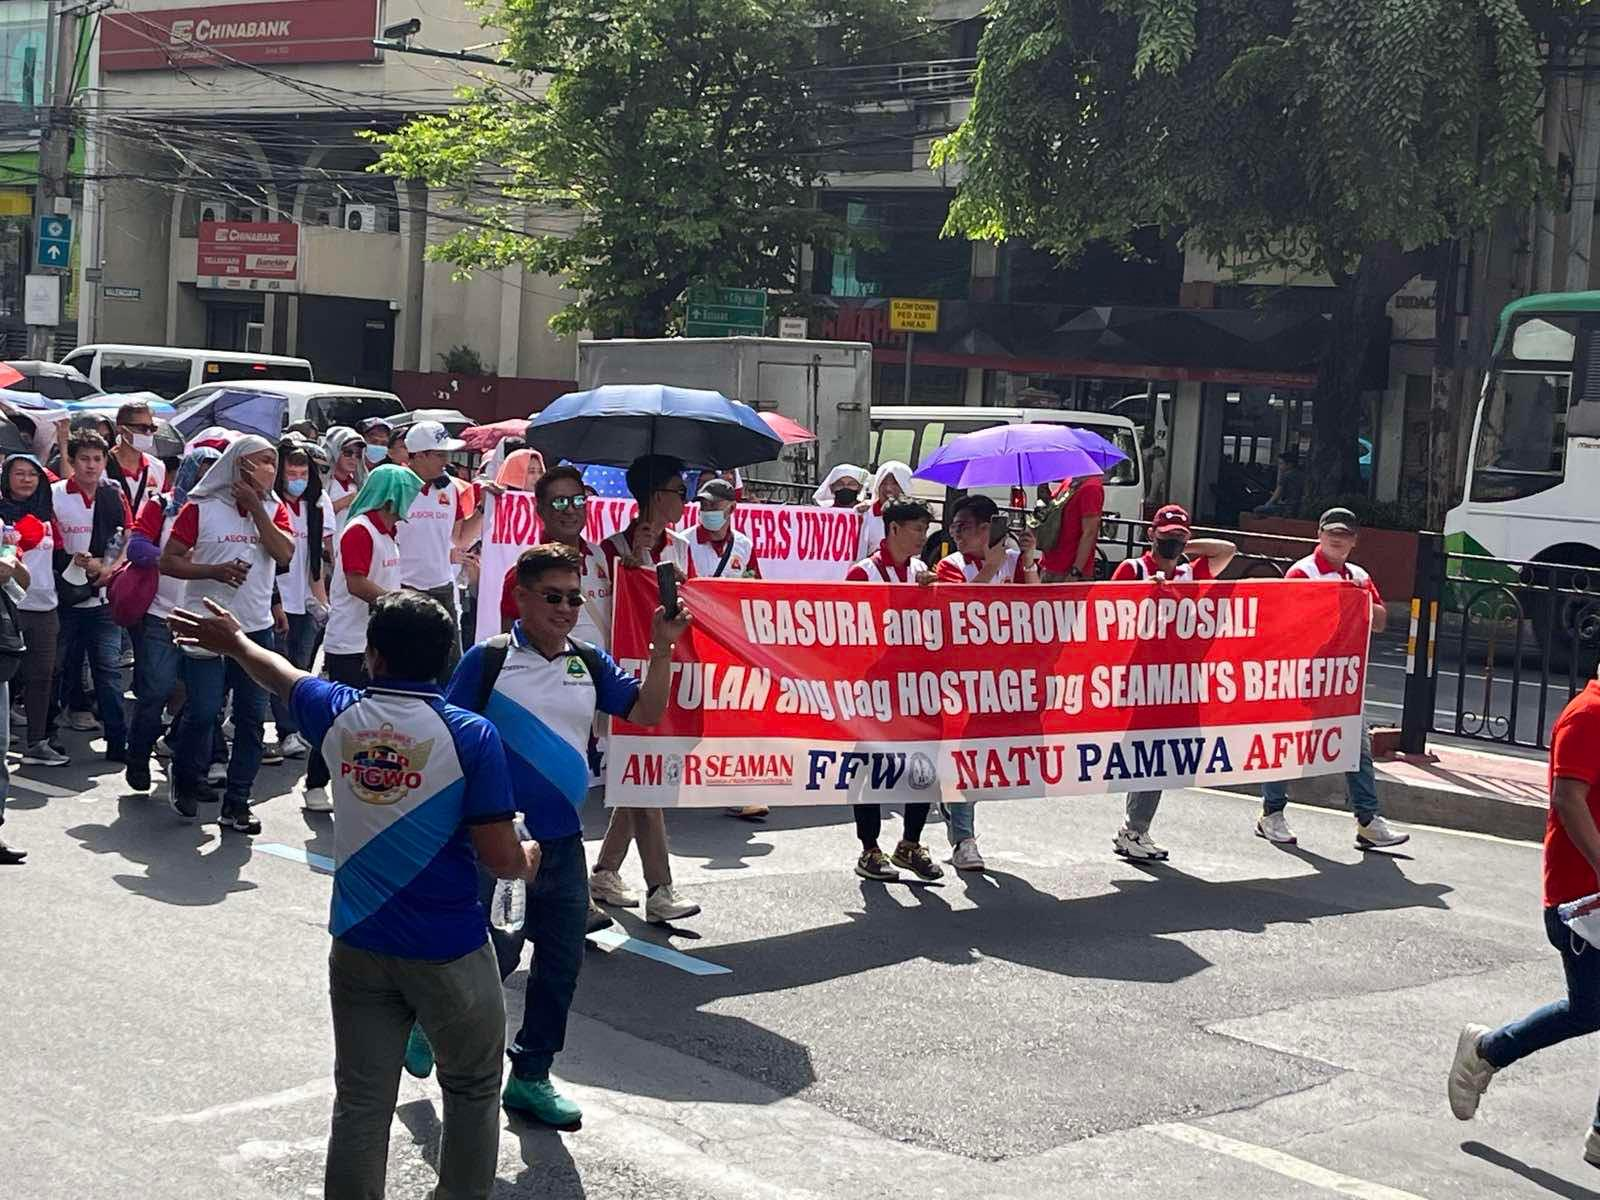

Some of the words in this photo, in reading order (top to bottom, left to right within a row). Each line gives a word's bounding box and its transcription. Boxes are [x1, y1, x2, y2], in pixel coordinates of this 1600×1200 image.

[196, 19, 291, 41] CHINABANK
[229, 229, 281, 242] CHINABANK
[894, 302, 913, 310] SLOW
[914, 303, 936, 311] DOWN
[897, 311, 912, 319] PED
[901, 320, 926, 328] AHEAD
[217, 533, 248, 544] LABOR
[796, 511, 863, 562] UNION
[740, 599, 878, 647] IBASURA
[884, 608, 945, 651] ang
[949, 599, 1088, 647] ESCROW
[1094, 597, 1259, 642] PROPOSAL!
[775, 675, 836, 722] ang
[833, 678, 894, 722] pag
[897, 668, 1040, 718] HOSTAGE
[1045, 673, 1084, 717] ng
[1090, 660, 1239, 710] SEAMAN'S
[1241, 655, 1361, 702] BENEFITS
[705, 754, 794, 778] SEAMAN
[805, 749, 907, 791] FFW
[951, 745, 1066, 790] NATU
[1076, 736, 1234, 783] PAMWA
[1242, 727, 1343, 772] AFWC
[341, 762, 423, 790] PTGWO
